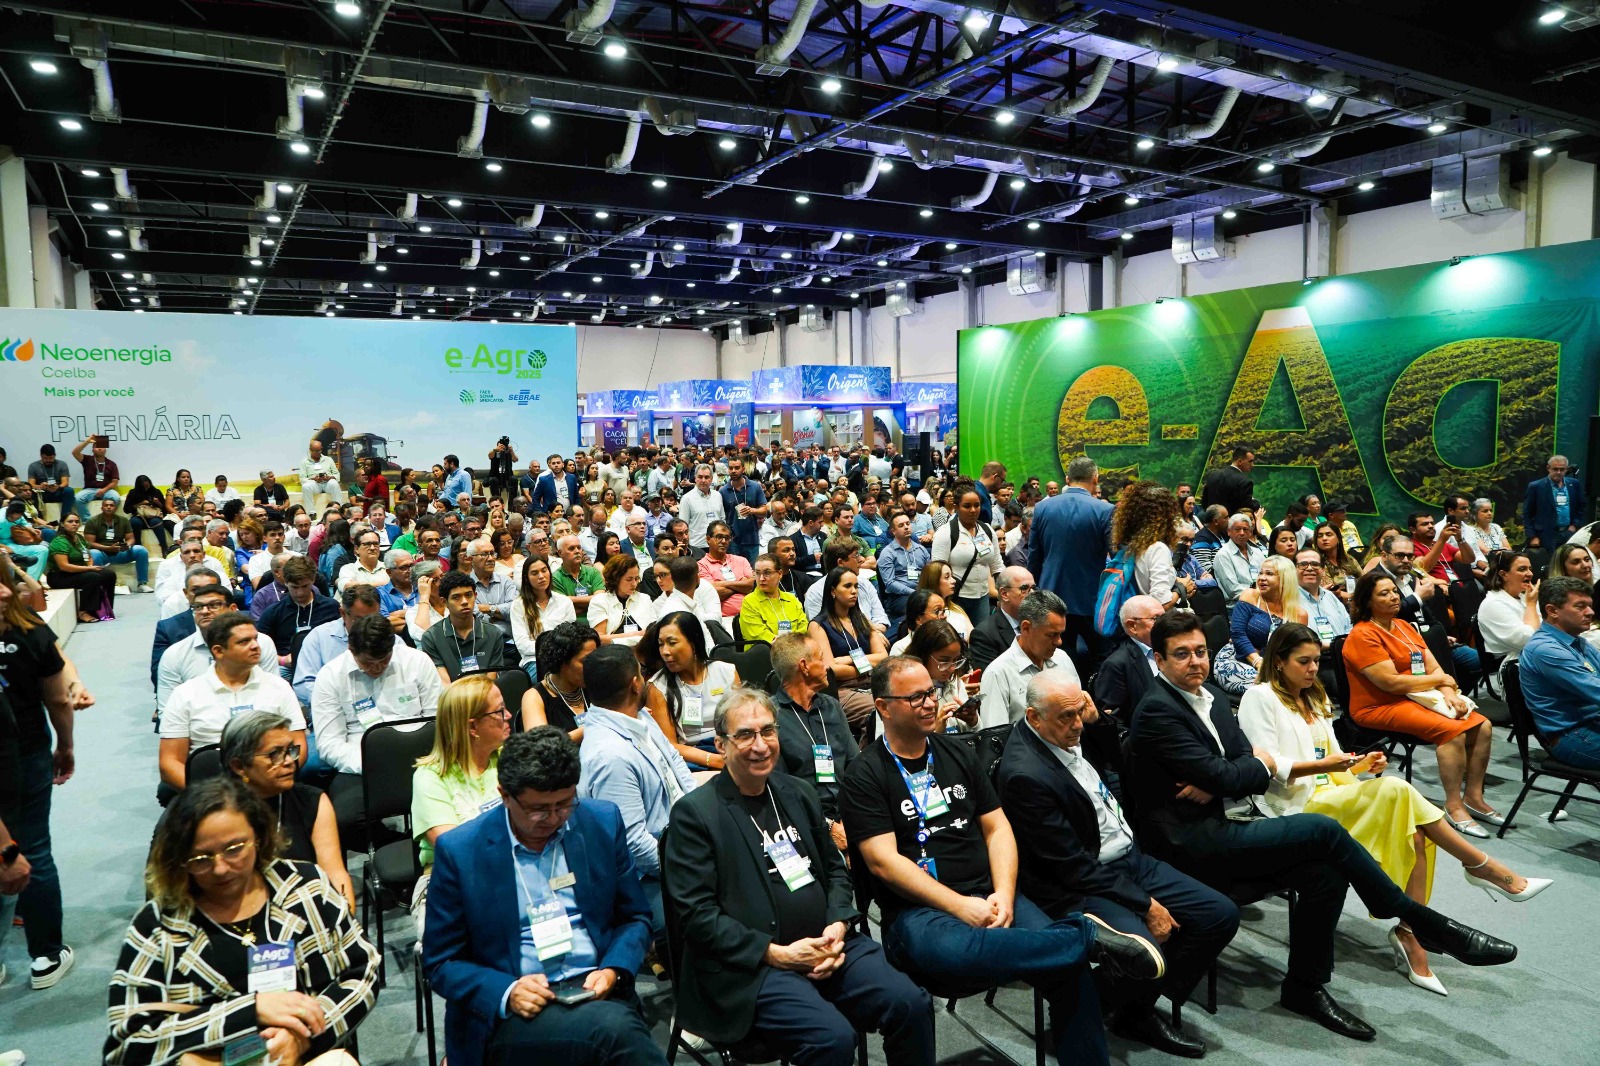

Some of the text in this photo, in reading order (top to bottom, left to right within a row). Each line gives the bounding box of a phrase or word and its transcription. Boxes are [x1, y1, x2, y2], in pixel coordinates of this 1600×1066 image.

[41, 343, 171, 365] Neoenergia
[41, 366, 96, 379] Coelba
[515, 369, 542, 379] 2025
[827, 373, 868, 393] Origens
[44, 386, 135, 398] Mais por você
[714, 386, 751, 404] Origens
[917, 388, 947, 404] Origens
[632, 395, 659, 409] Origen
[50, 406, 241, 442] PLENÁRIA
